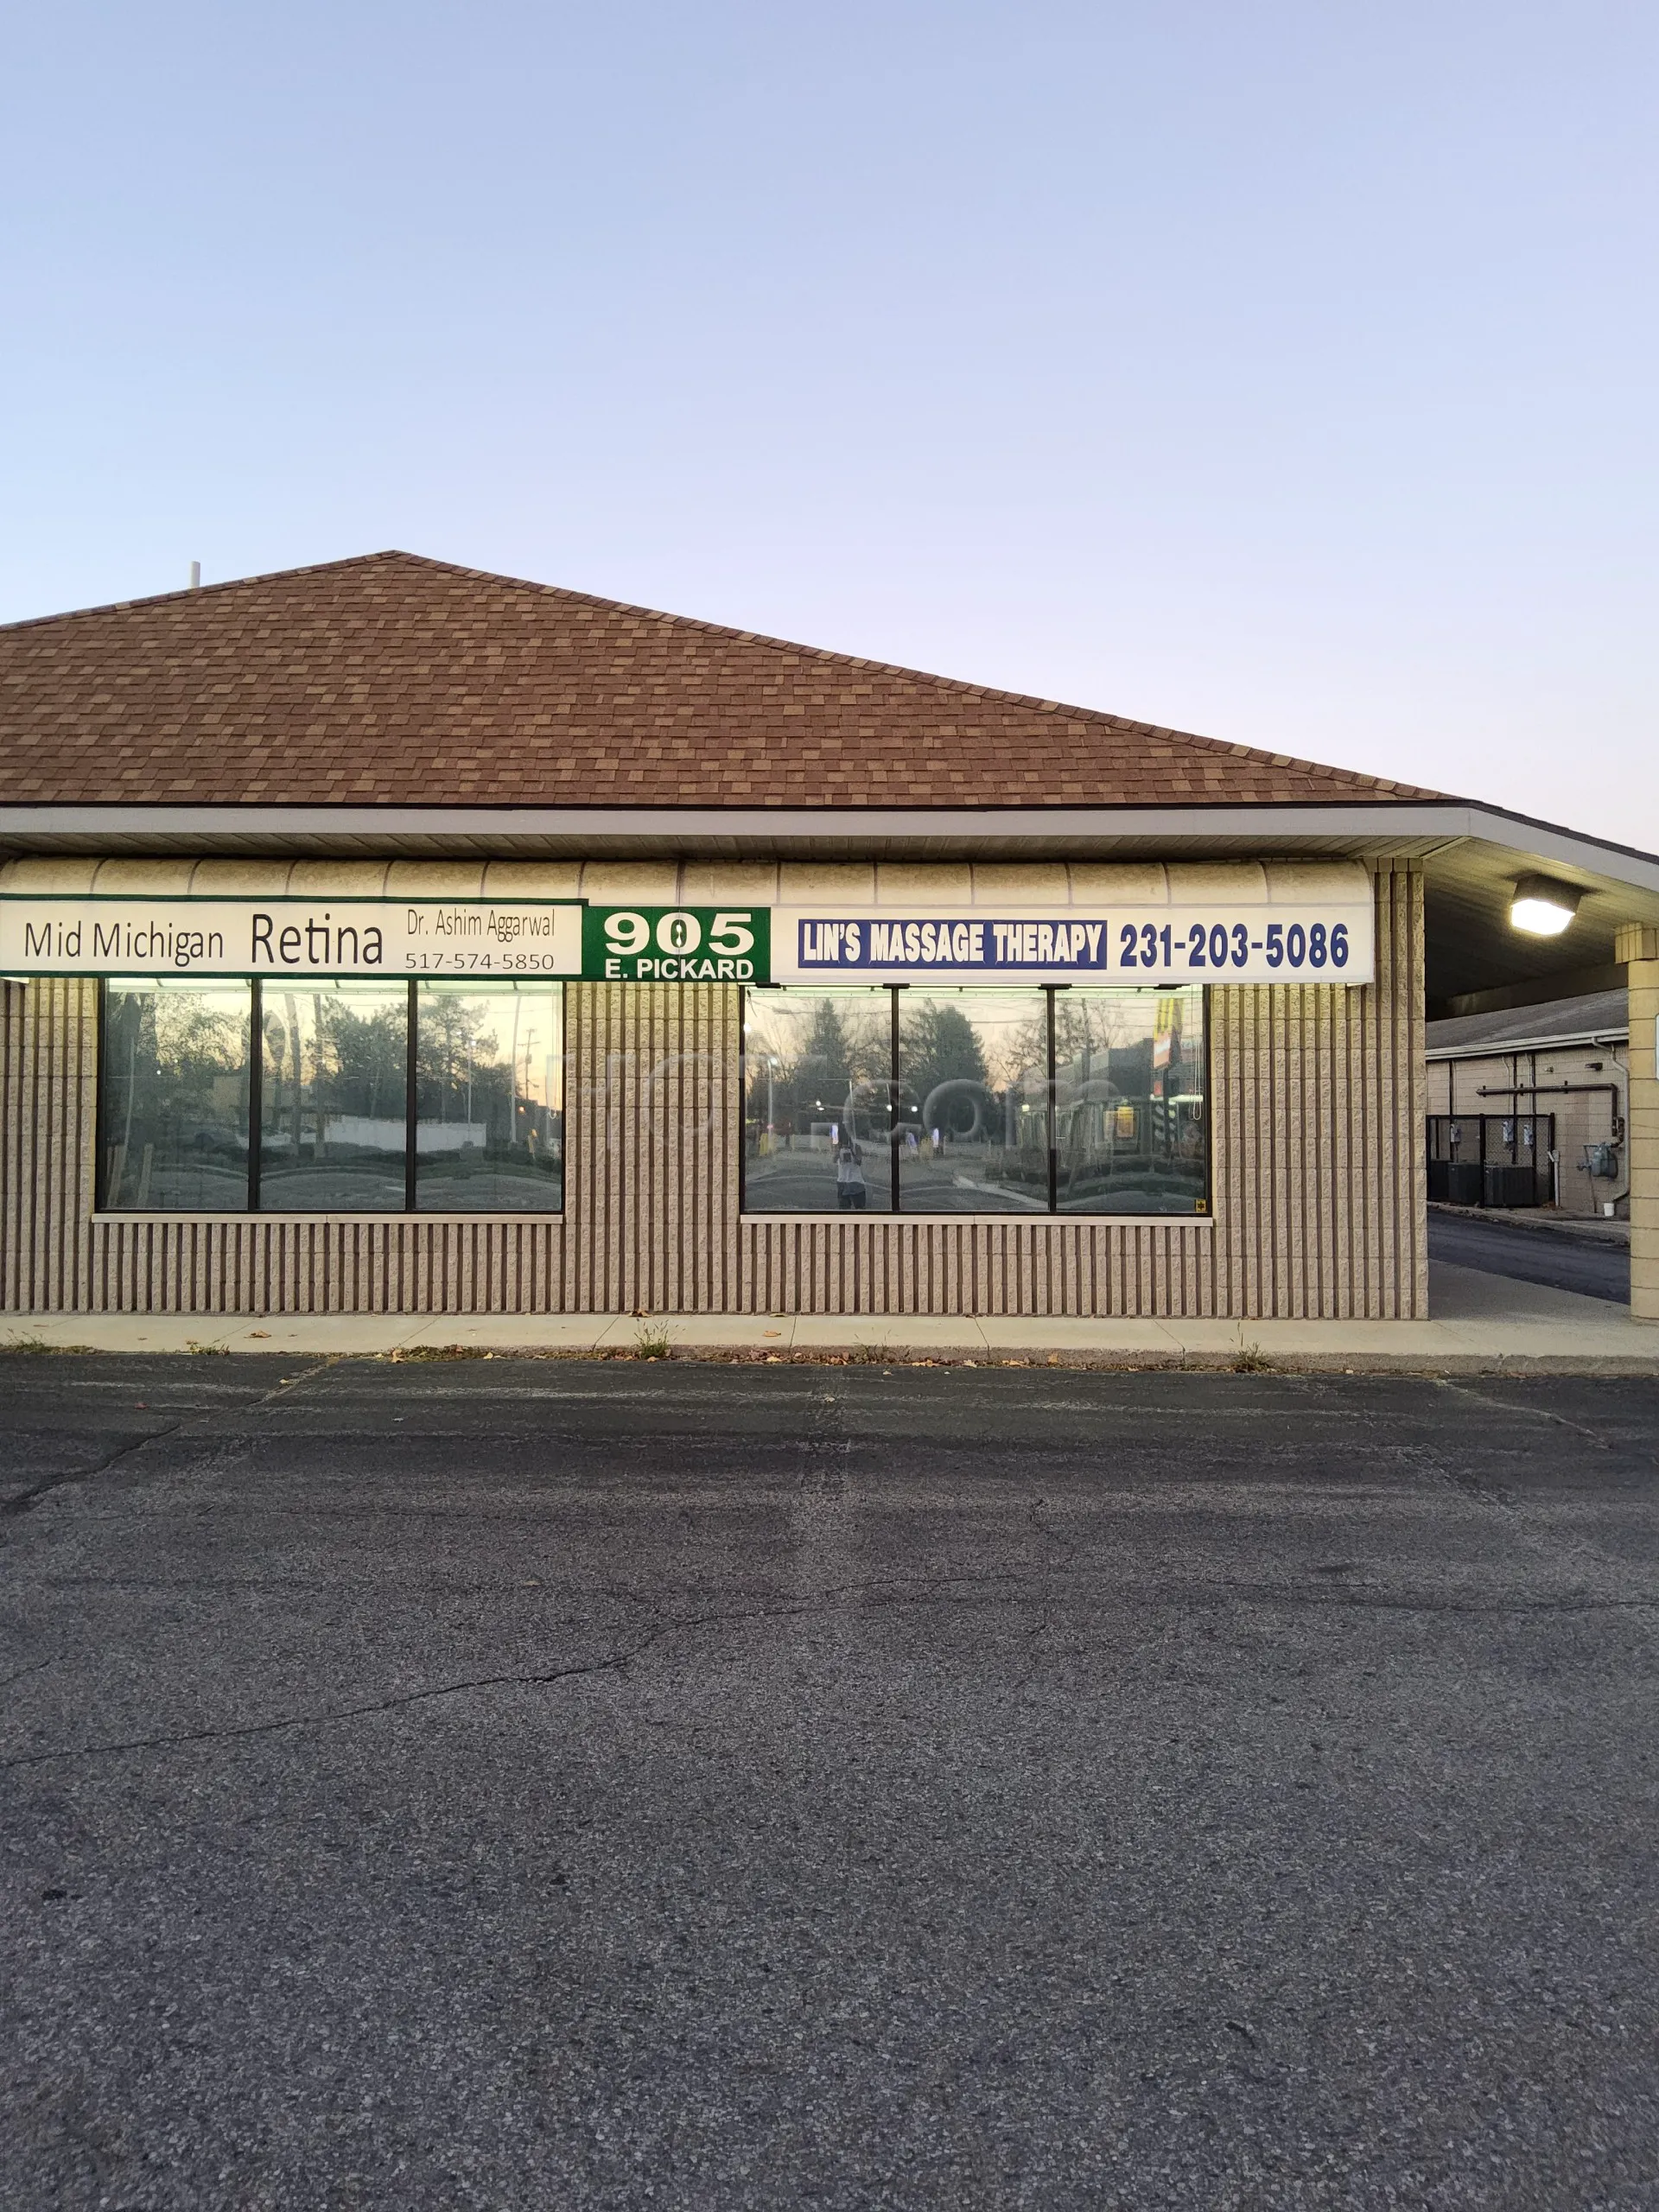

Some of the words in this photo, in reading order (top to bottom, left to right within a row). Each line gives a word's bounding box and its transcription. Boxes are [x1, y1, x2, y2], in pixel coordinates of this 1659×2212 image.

[25, 919, 81, 958] Mid
[93, 919, 223, 968] Michigan
[251, 912, 383, 965] Retina
[407, 908, 429, 936] Dr.
[435, 907, 482, 936] Ashim
[486, 907, 556, 943] Aggarwal
[604, 912, 755, 956] 905
[405, 953, 555, 970] 517-574-5850
[804, 922, 861, 963] LIN'S
[869, 922, 984, 963] MASSAGE
[992, 922, 1103, 963] THERAPY
[1120, 923, 1350, 969] 231-203-5086
[605, 958, 629, 979] E.
[637, 958, 754, 980] PICKARD
